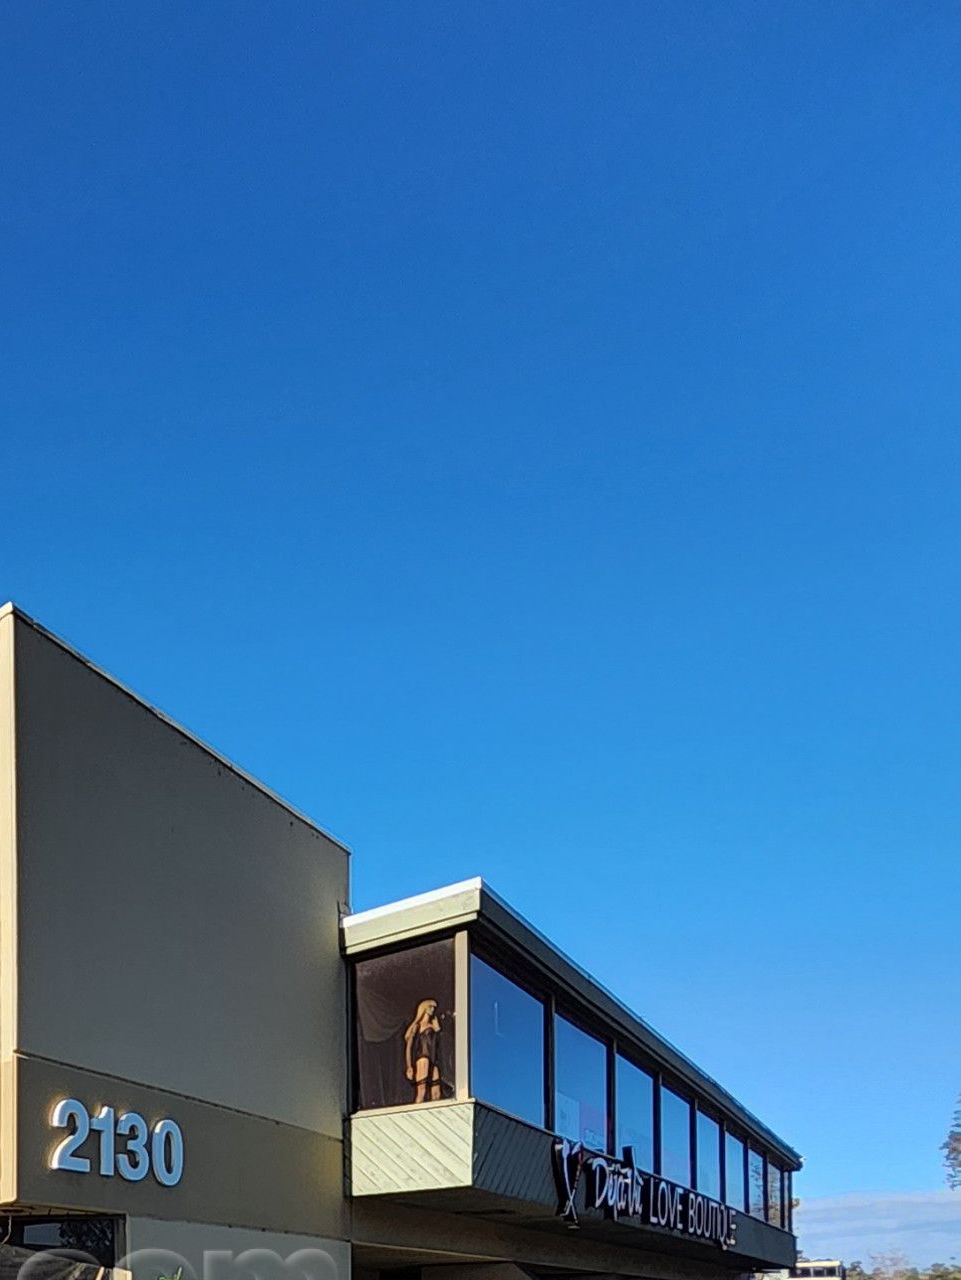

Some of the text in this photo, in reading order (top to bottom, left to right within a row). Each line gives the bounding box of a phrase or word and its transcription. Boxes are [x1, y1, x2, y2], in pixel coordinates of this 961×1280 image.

[48, 1098, 185, 1188] 2130
[650, 1177, 684, 1230] LOVE
[688, 1193, 736, 1251] BOUTIQUE
